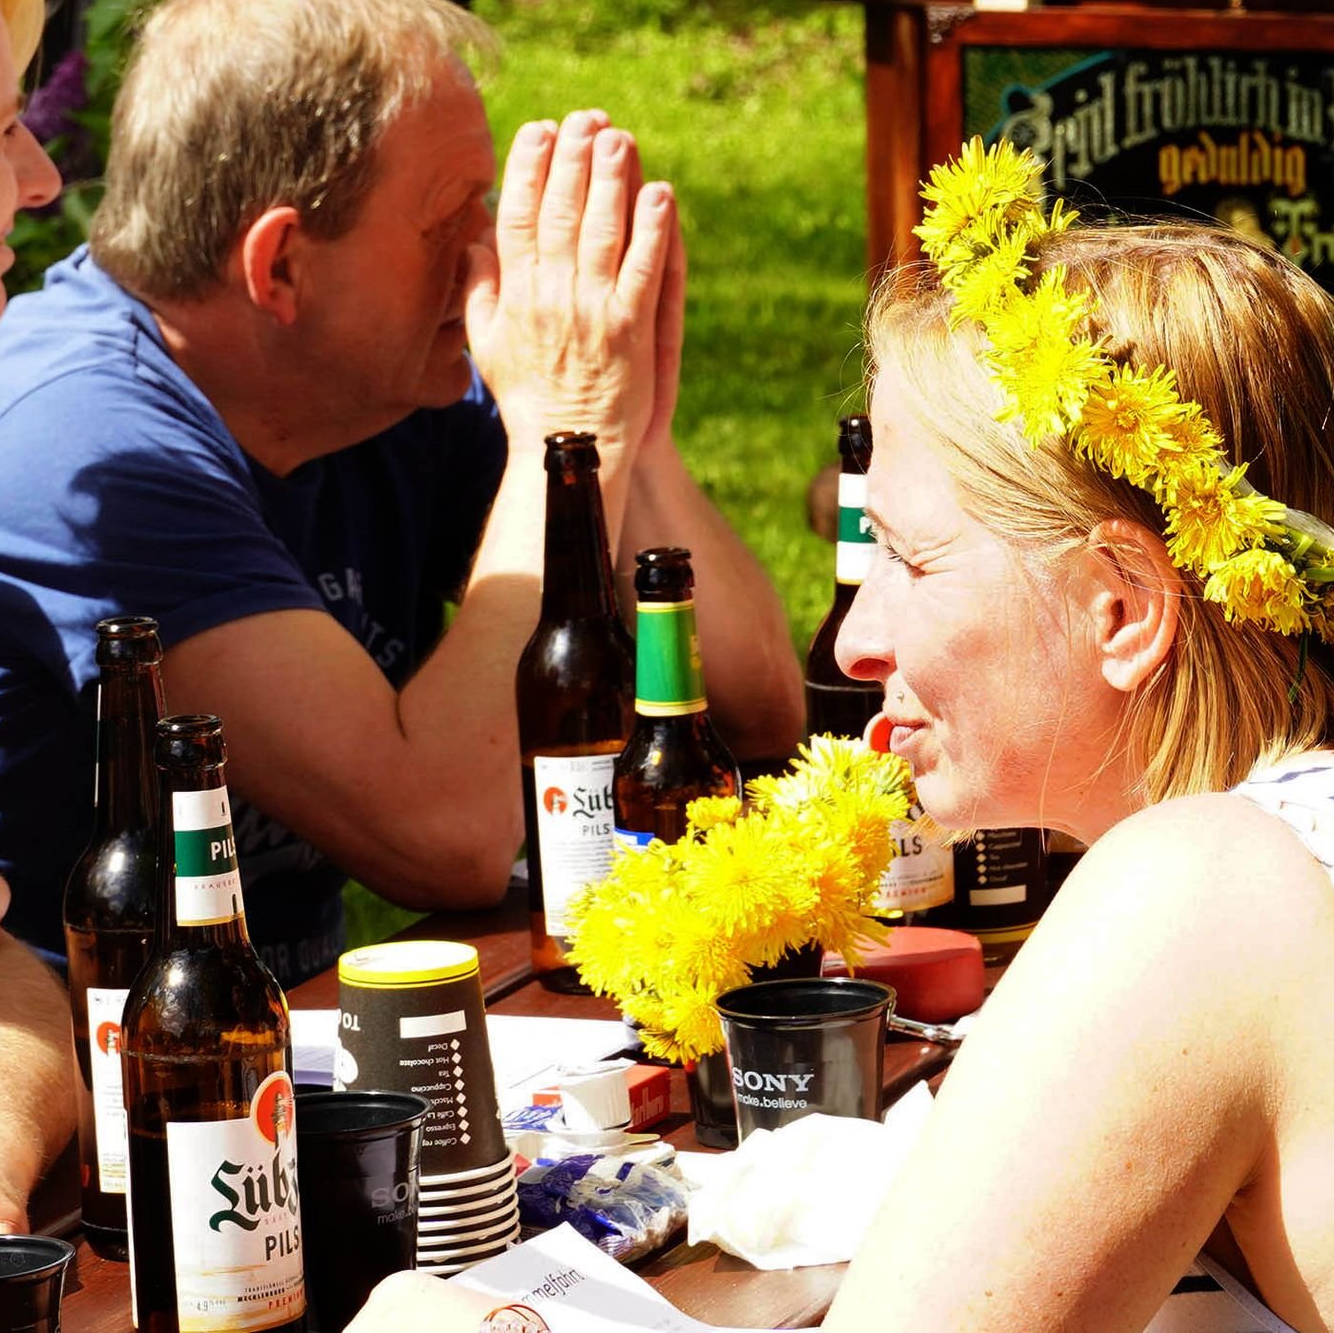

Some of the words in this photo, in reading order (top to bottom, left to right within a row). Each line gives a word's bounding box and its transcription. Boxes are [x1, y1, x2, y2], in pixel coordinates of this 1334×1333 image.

[732, 1066, 815, 1092] SONY
[371, 1182, 409, 1208] SO
[265, 1224, 300, 1262] PILS
